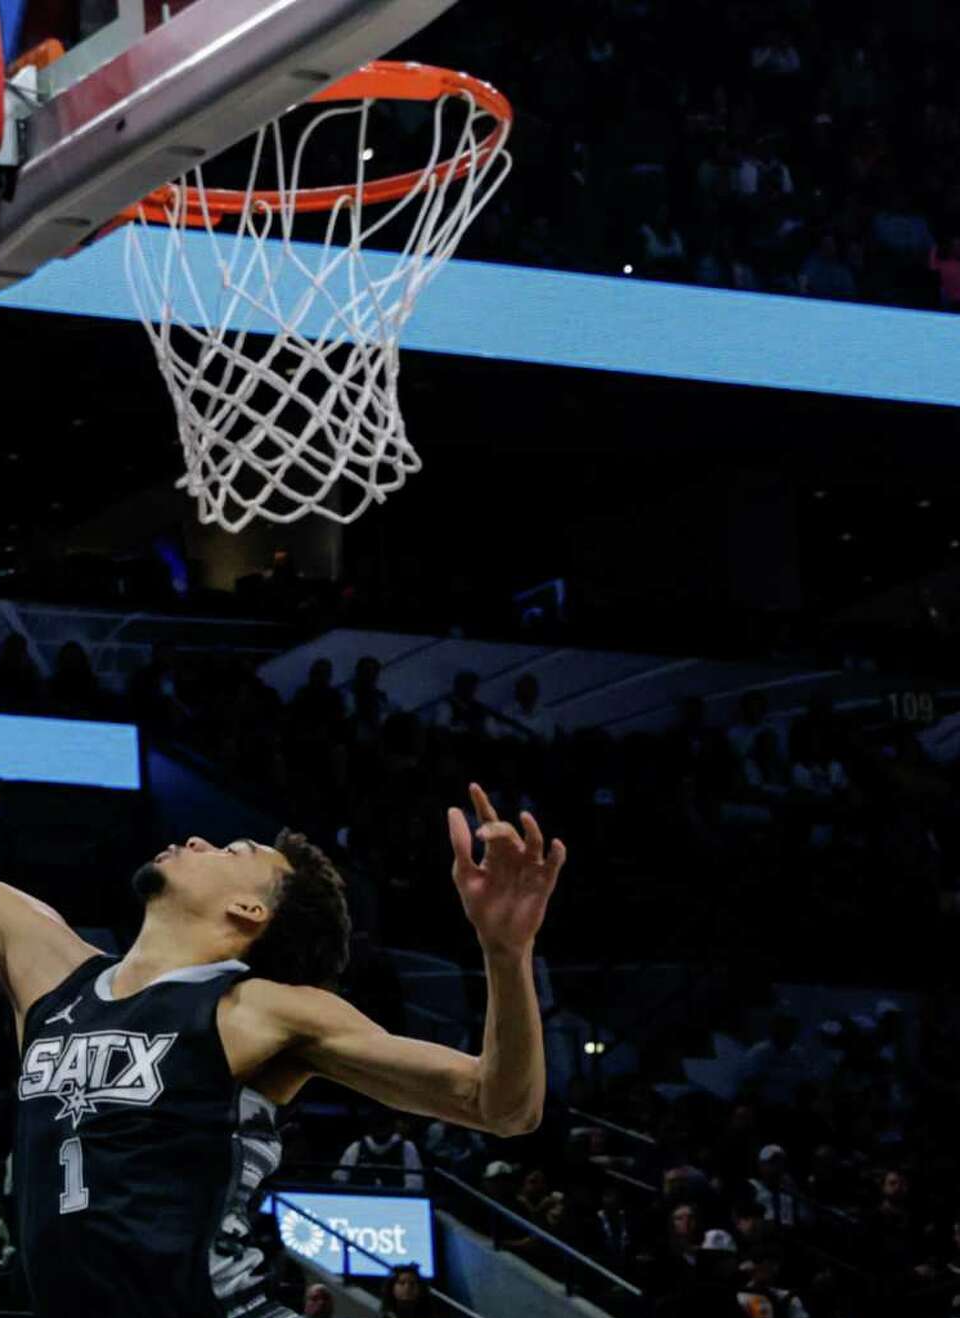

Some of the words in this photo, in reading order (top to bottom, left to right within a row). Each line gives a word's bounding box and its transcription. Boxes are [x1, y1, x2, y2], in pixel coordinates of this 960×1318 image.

[18, 1029, 179, 1106] SATX
[59, 1136, 90, 1215] 1
[328, 1217, 408, 1255] Frost
